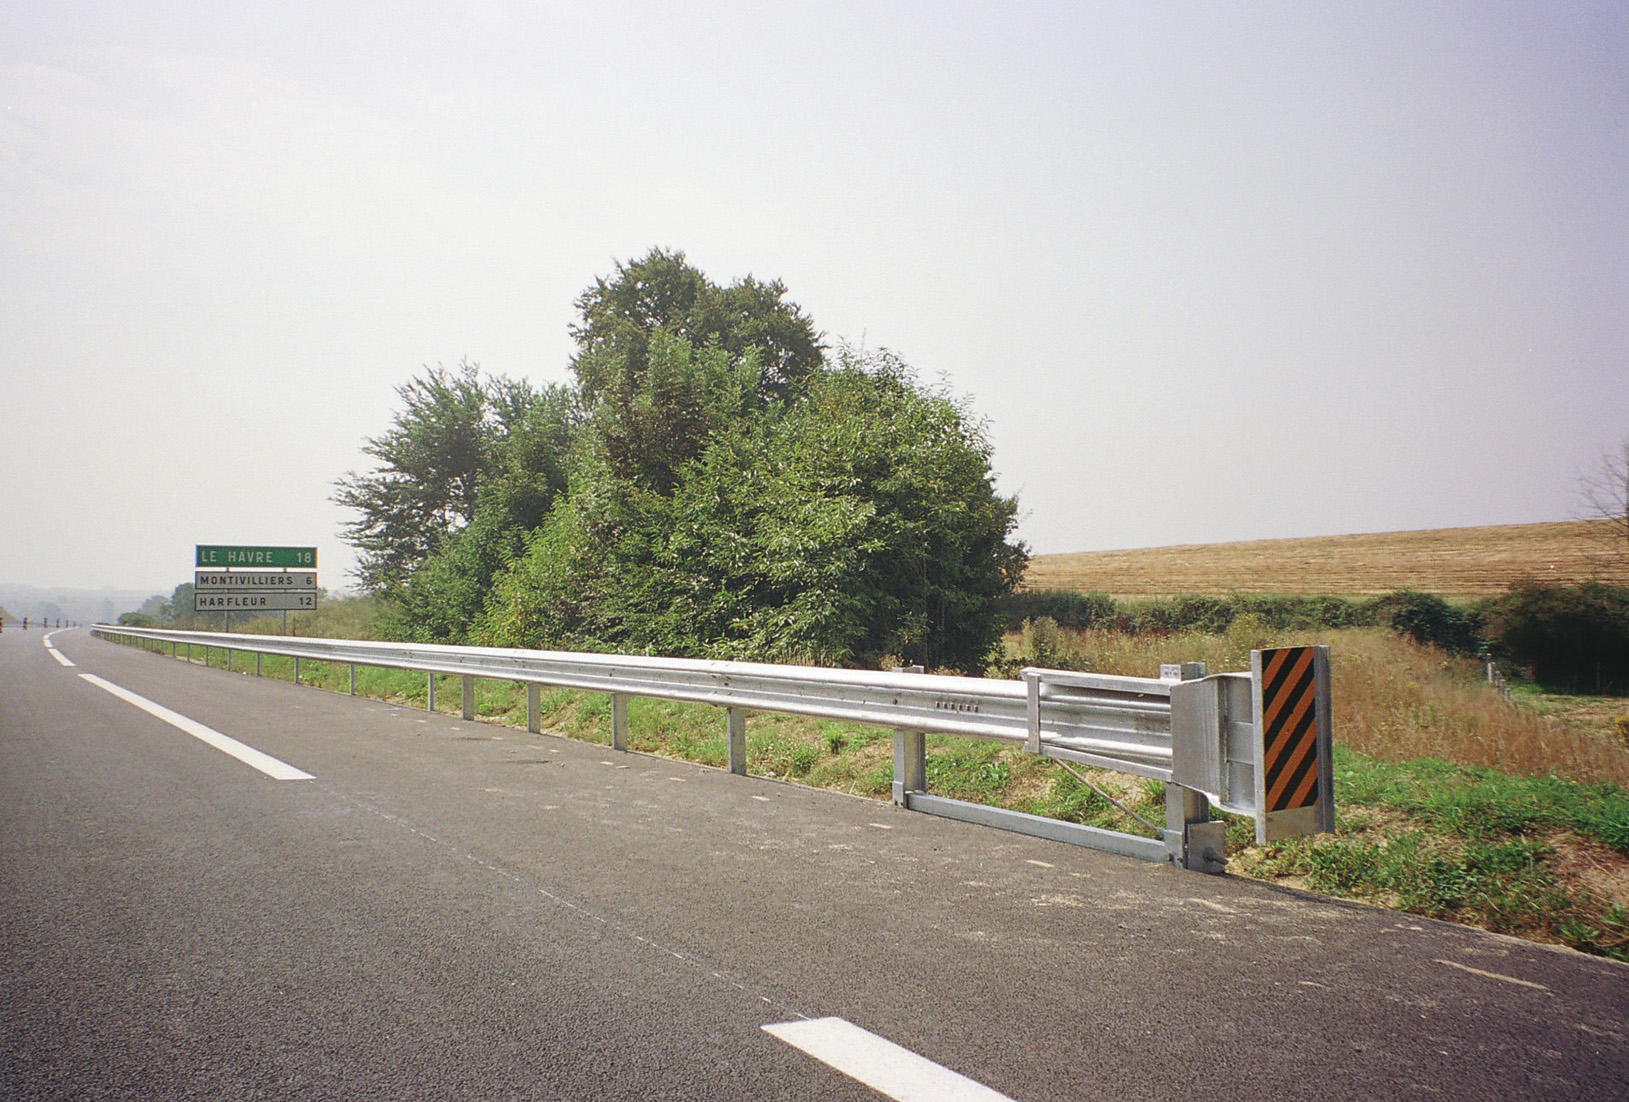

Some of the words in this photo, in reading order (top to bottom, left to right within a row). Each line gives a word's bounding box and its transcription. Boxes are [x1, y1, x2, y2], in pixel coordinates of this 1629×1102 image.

[201, 550, 217, 563] LE
[228, 551, 274, 563] HAVRE
[296, 552, 312, 564] 18
[200, 576, 293, 585] MONTIVILLIERS
[306, 576, 312, 585] 6
[199, 597, 267, 607] HARFLEUR
[299, 597, 312, 606] 12
